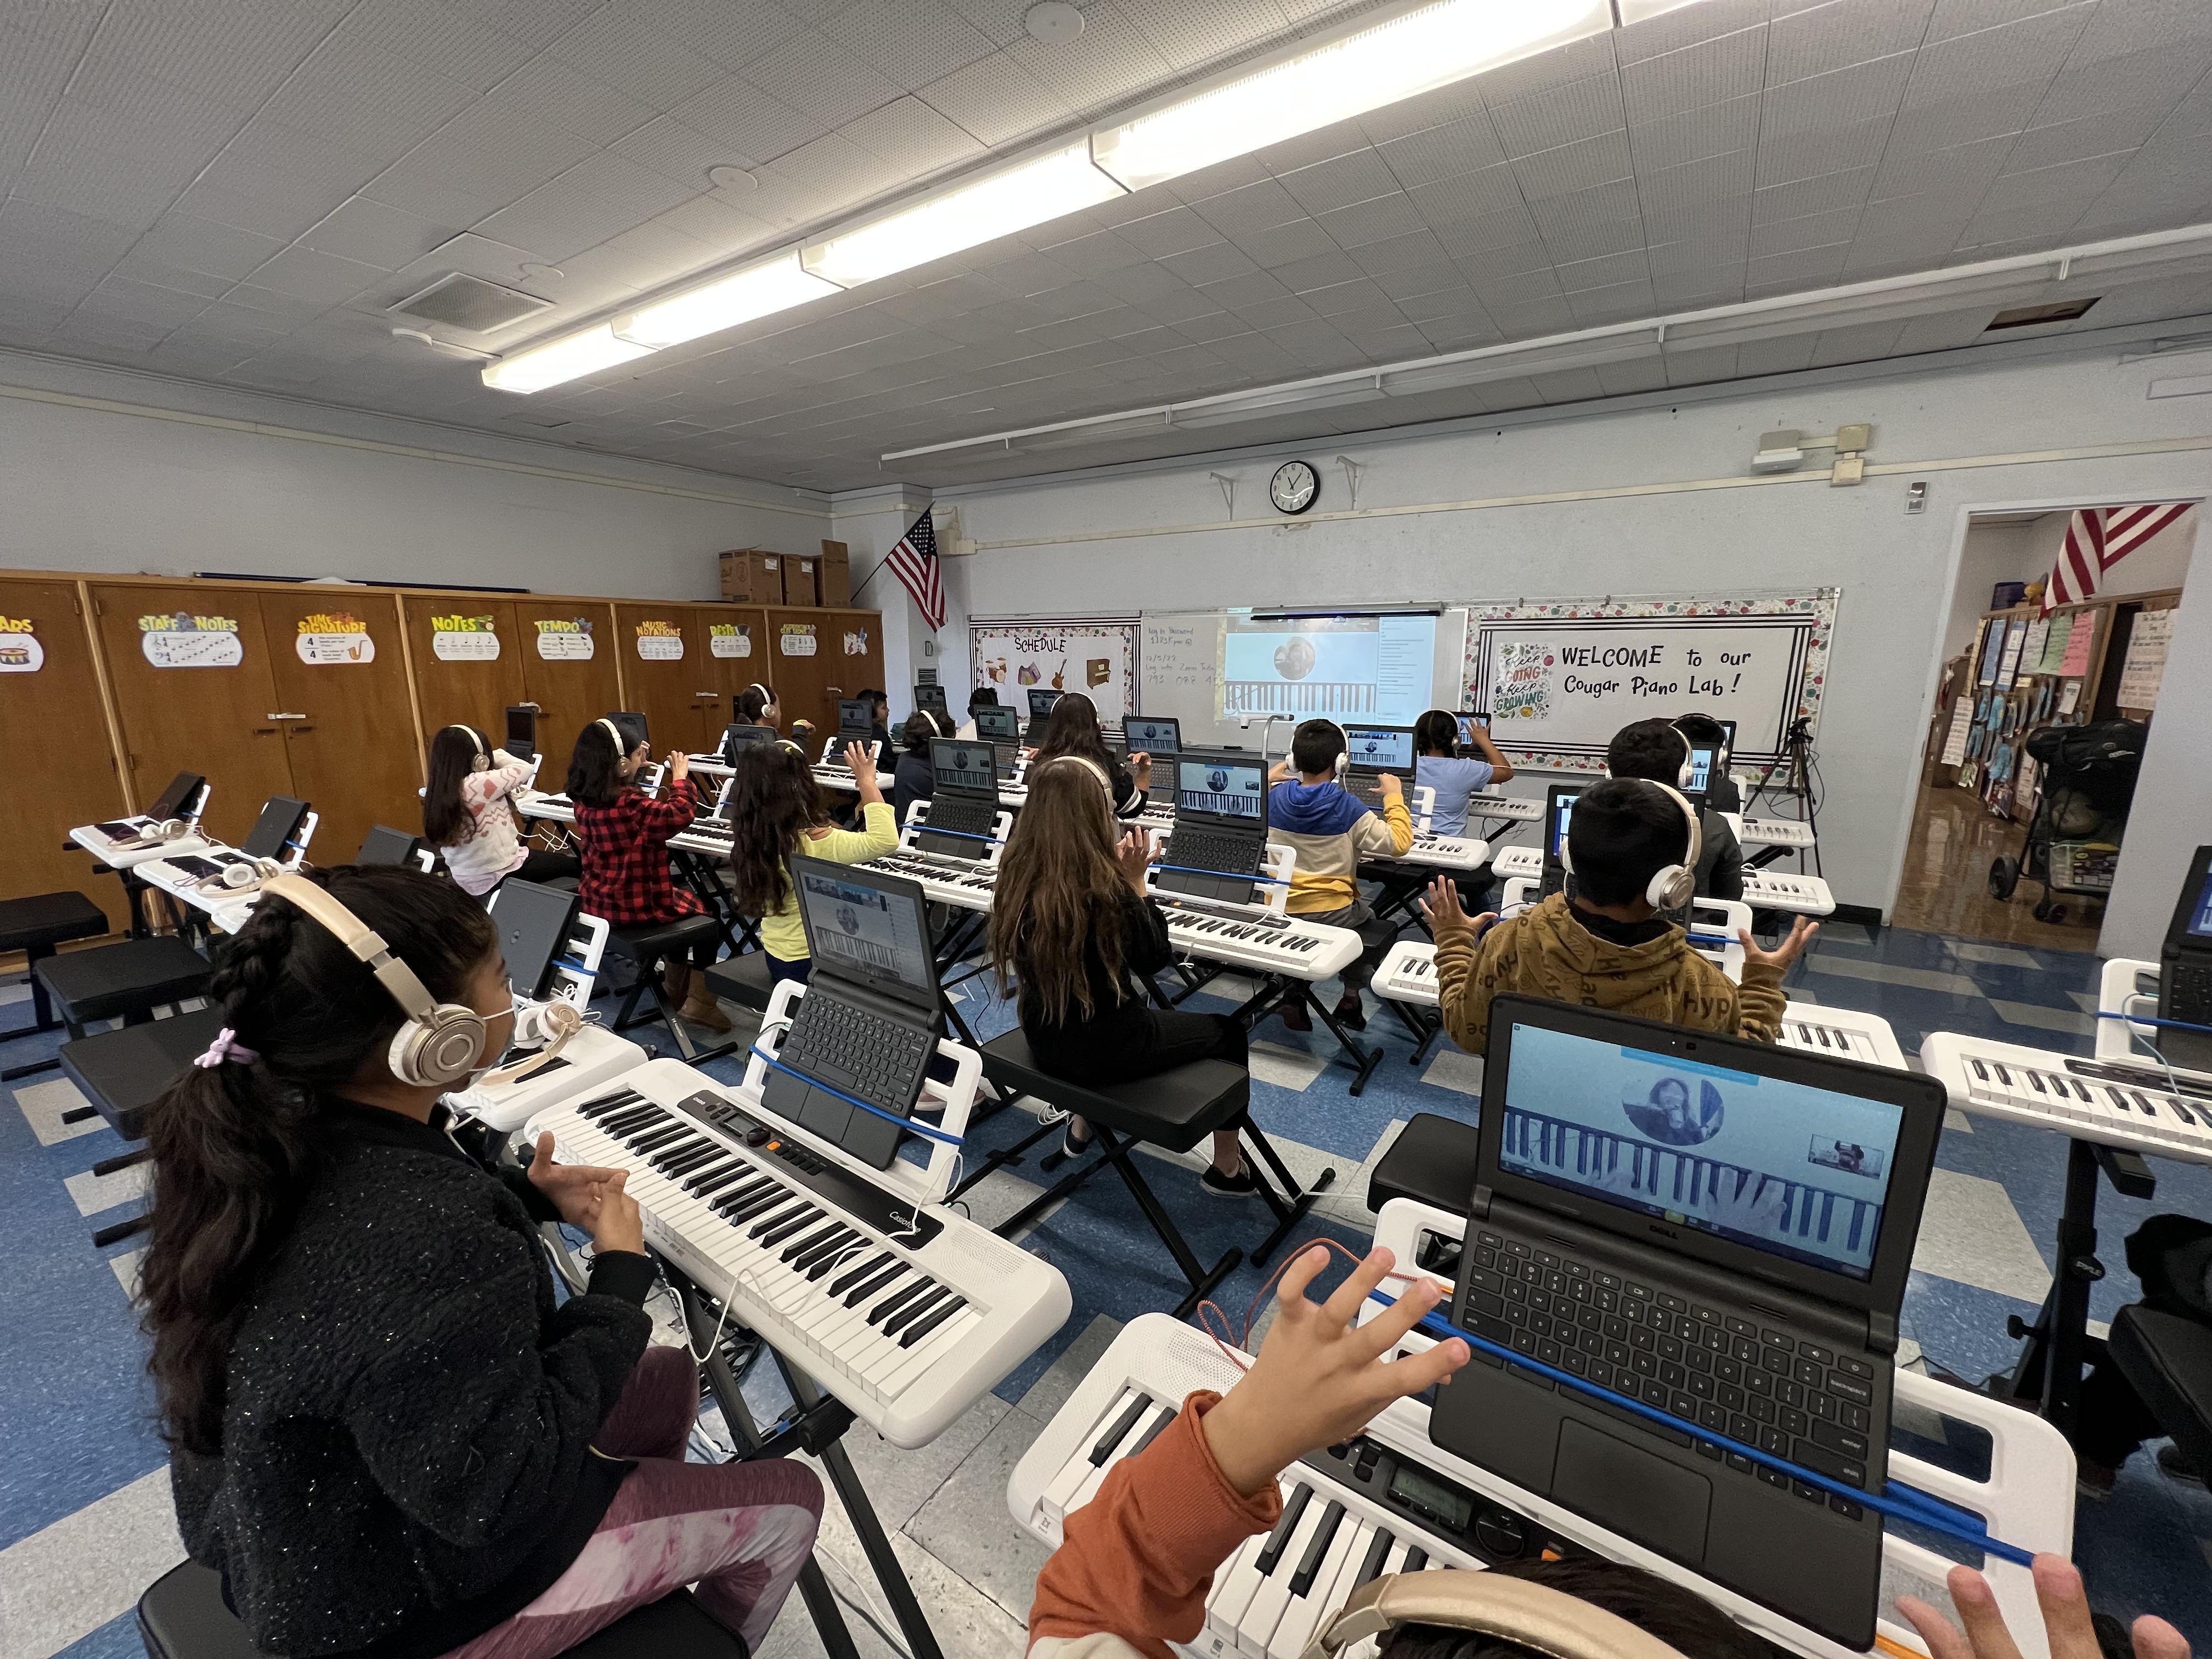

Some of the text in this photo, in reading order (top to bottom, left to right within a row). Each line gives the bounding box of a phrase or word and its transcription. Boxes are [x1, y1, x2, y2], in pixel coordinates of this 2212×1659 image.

[138, 614, 238, 632] STAFF NOTES
[306, 614, 331, 624] TIME
[431, 614, 476, 632] NOTES
[534, 620, 580, 633] TEMPO
[642, 621, 667, 629] MUSIC
[297, 621, 366, 634] SIGNATURE
[635, 626, 681, 636] NOTATIONS
[307, 637, 313, 646] 4
[1014, 637, 1066, 653] SCHEDULE
[1562, 645, 1751, 668] WELCOME to our
[1505, 666, 1541, 683] GOING
[1564, 675, 1620, 698] Cougar
[1631, 676, 1678, 697] Piano
[1689, 675, 1723, 696] Lab
[1496, 691, 1544, 711] GROWING
[889, 1211, 921, 1235] Casiotoe
